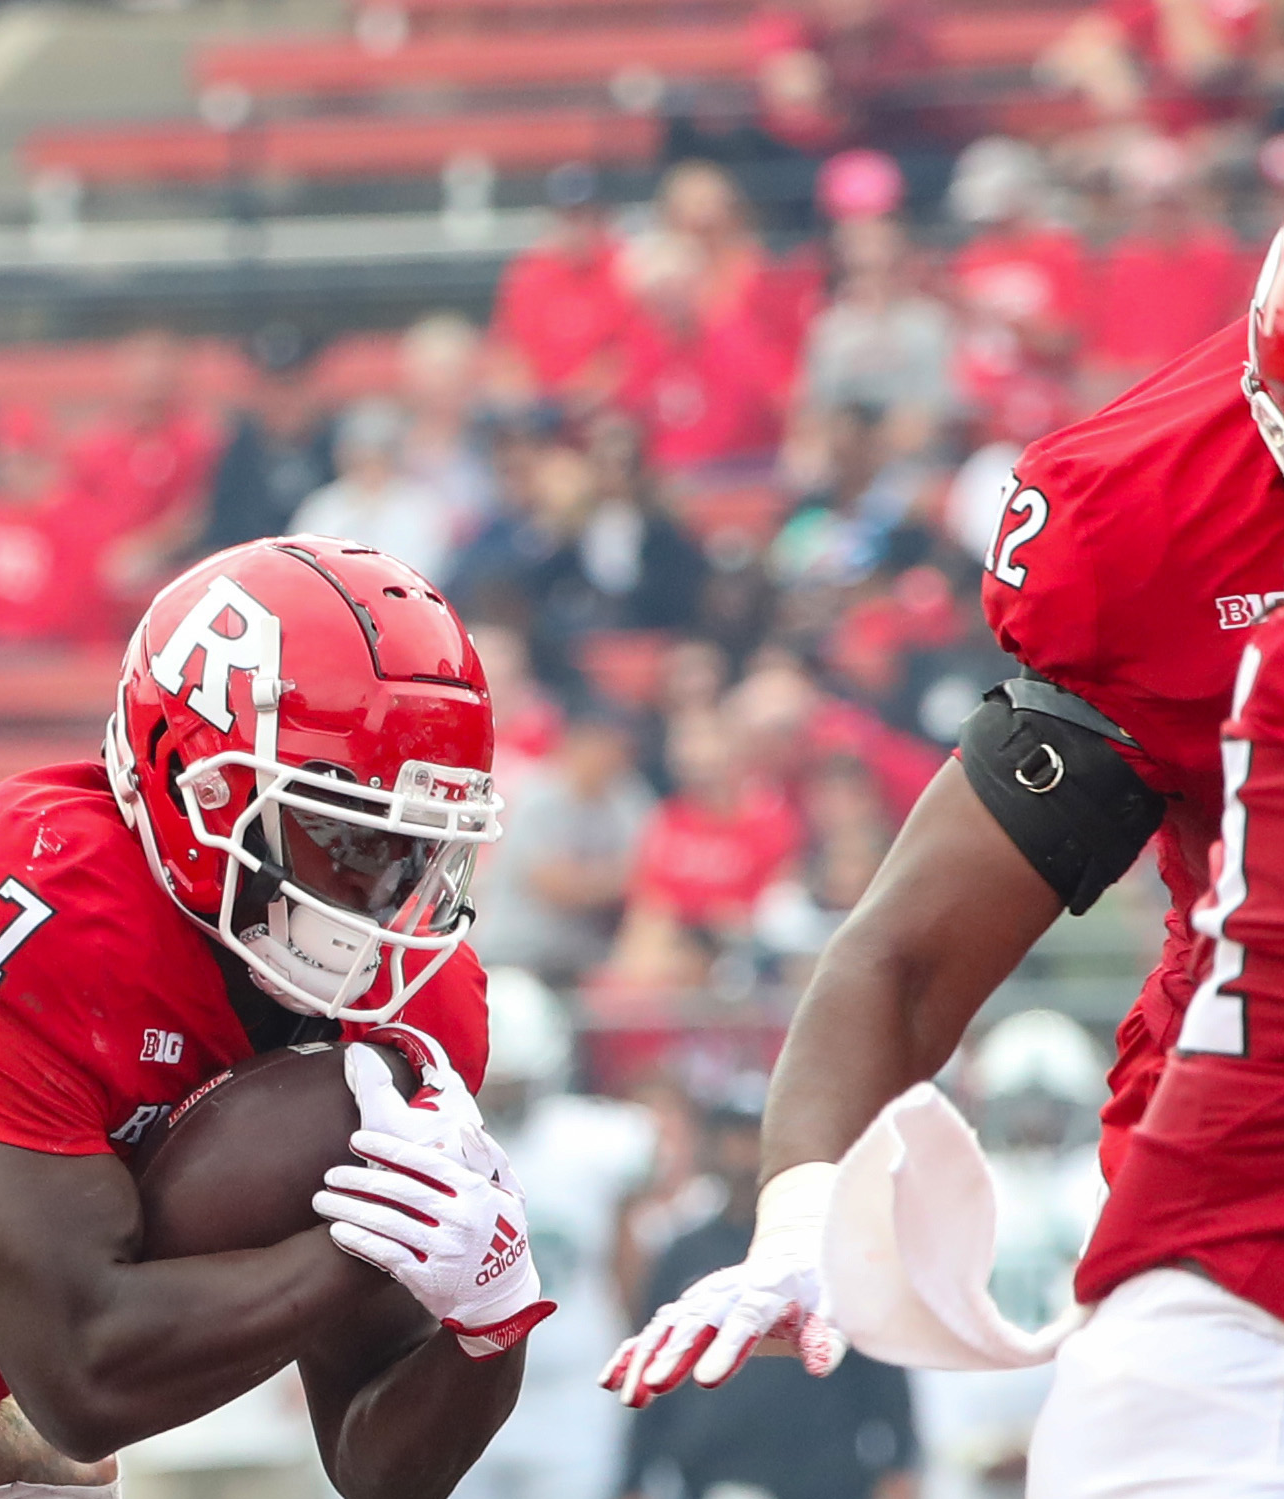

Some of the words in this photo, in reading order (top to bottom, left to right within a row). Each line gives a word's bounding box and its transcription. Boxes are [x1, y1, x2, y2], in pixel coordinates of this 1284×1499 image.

[151, 574, 282, 735] R
[139, 1028, 185, 1064] BIG
[475, 1234, 526, 1287] adidas
